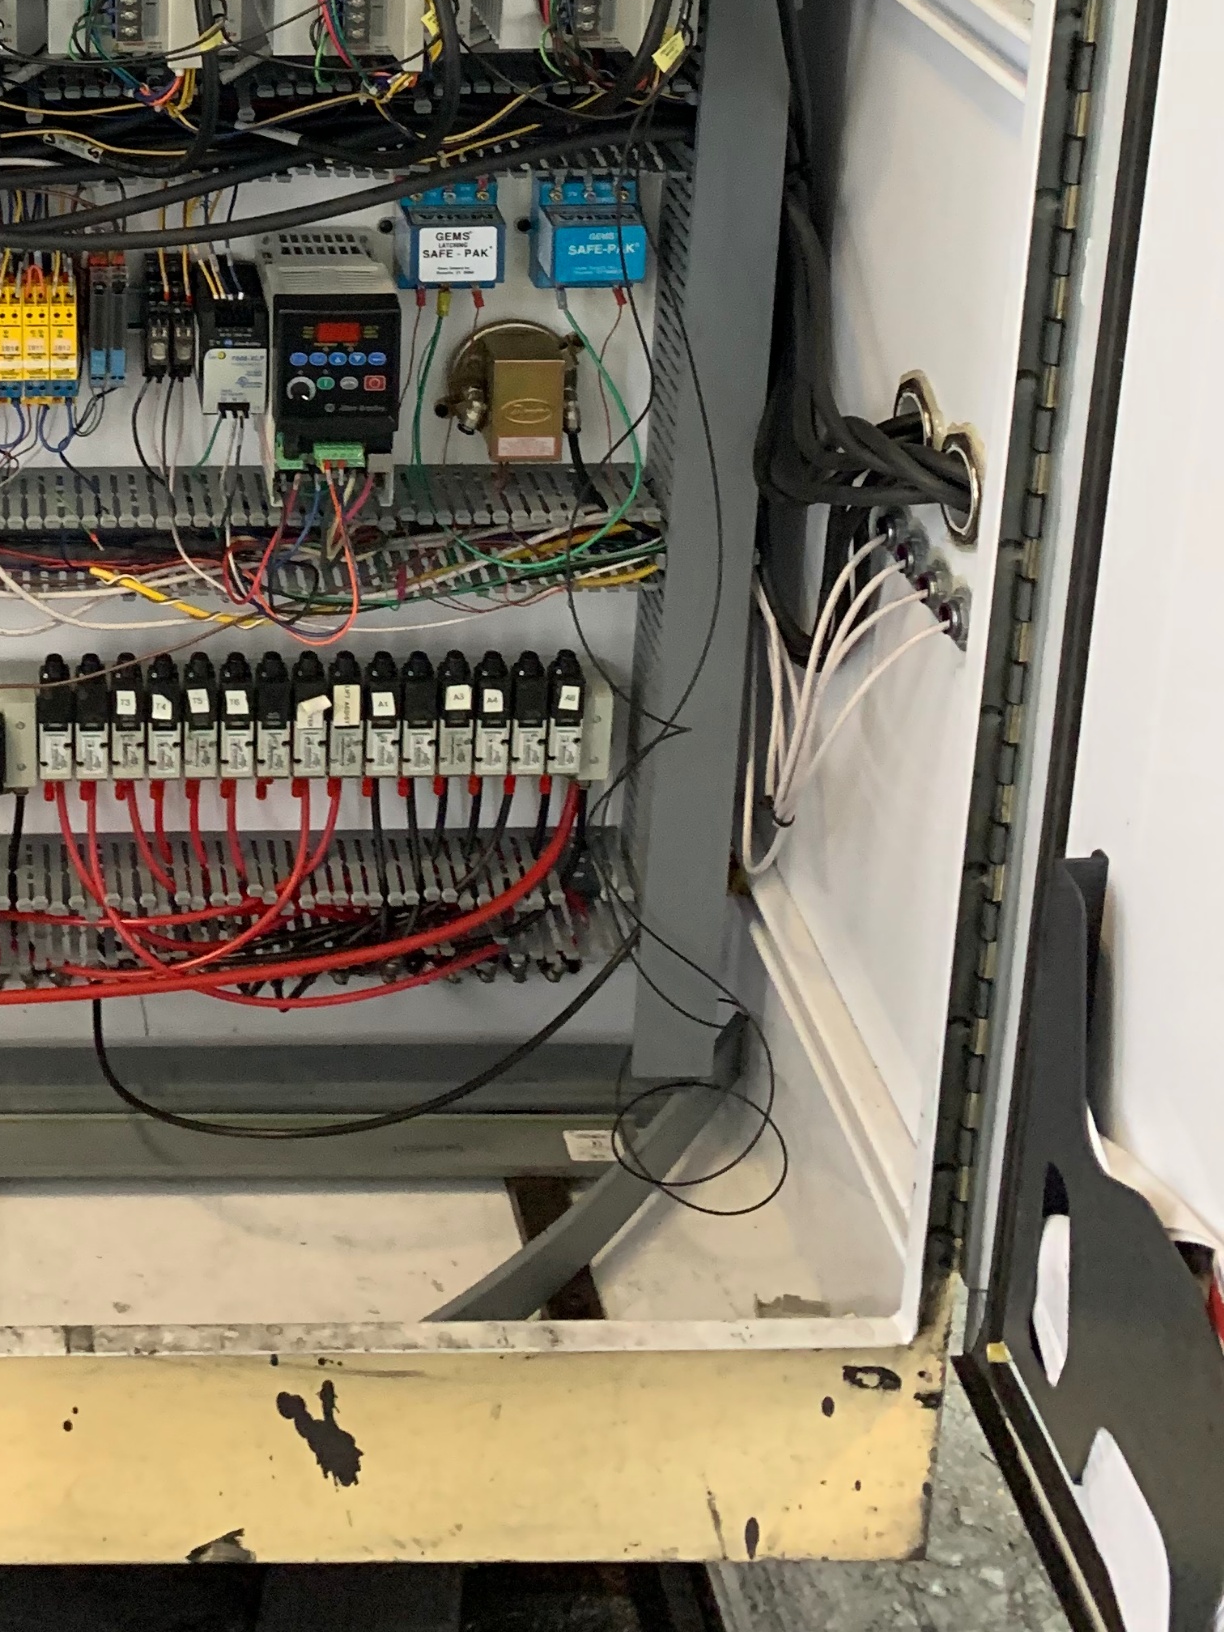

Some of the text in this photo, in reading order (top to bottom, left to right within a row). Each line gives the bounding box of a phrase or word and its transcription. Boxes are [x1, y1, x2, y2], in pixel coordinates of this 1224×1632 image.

[435, 231, 471, 242] GEMS
[422, 249, 454, 259] SAFE
[464, 248, 489, 258] PAK
[192, 696, 204, 706] T5
[453, 691, 466, 701] A3
[486, 695, 499, 705] A4
[120, 698, 131, 708] T3
[155, 701, 167, 712] T4
